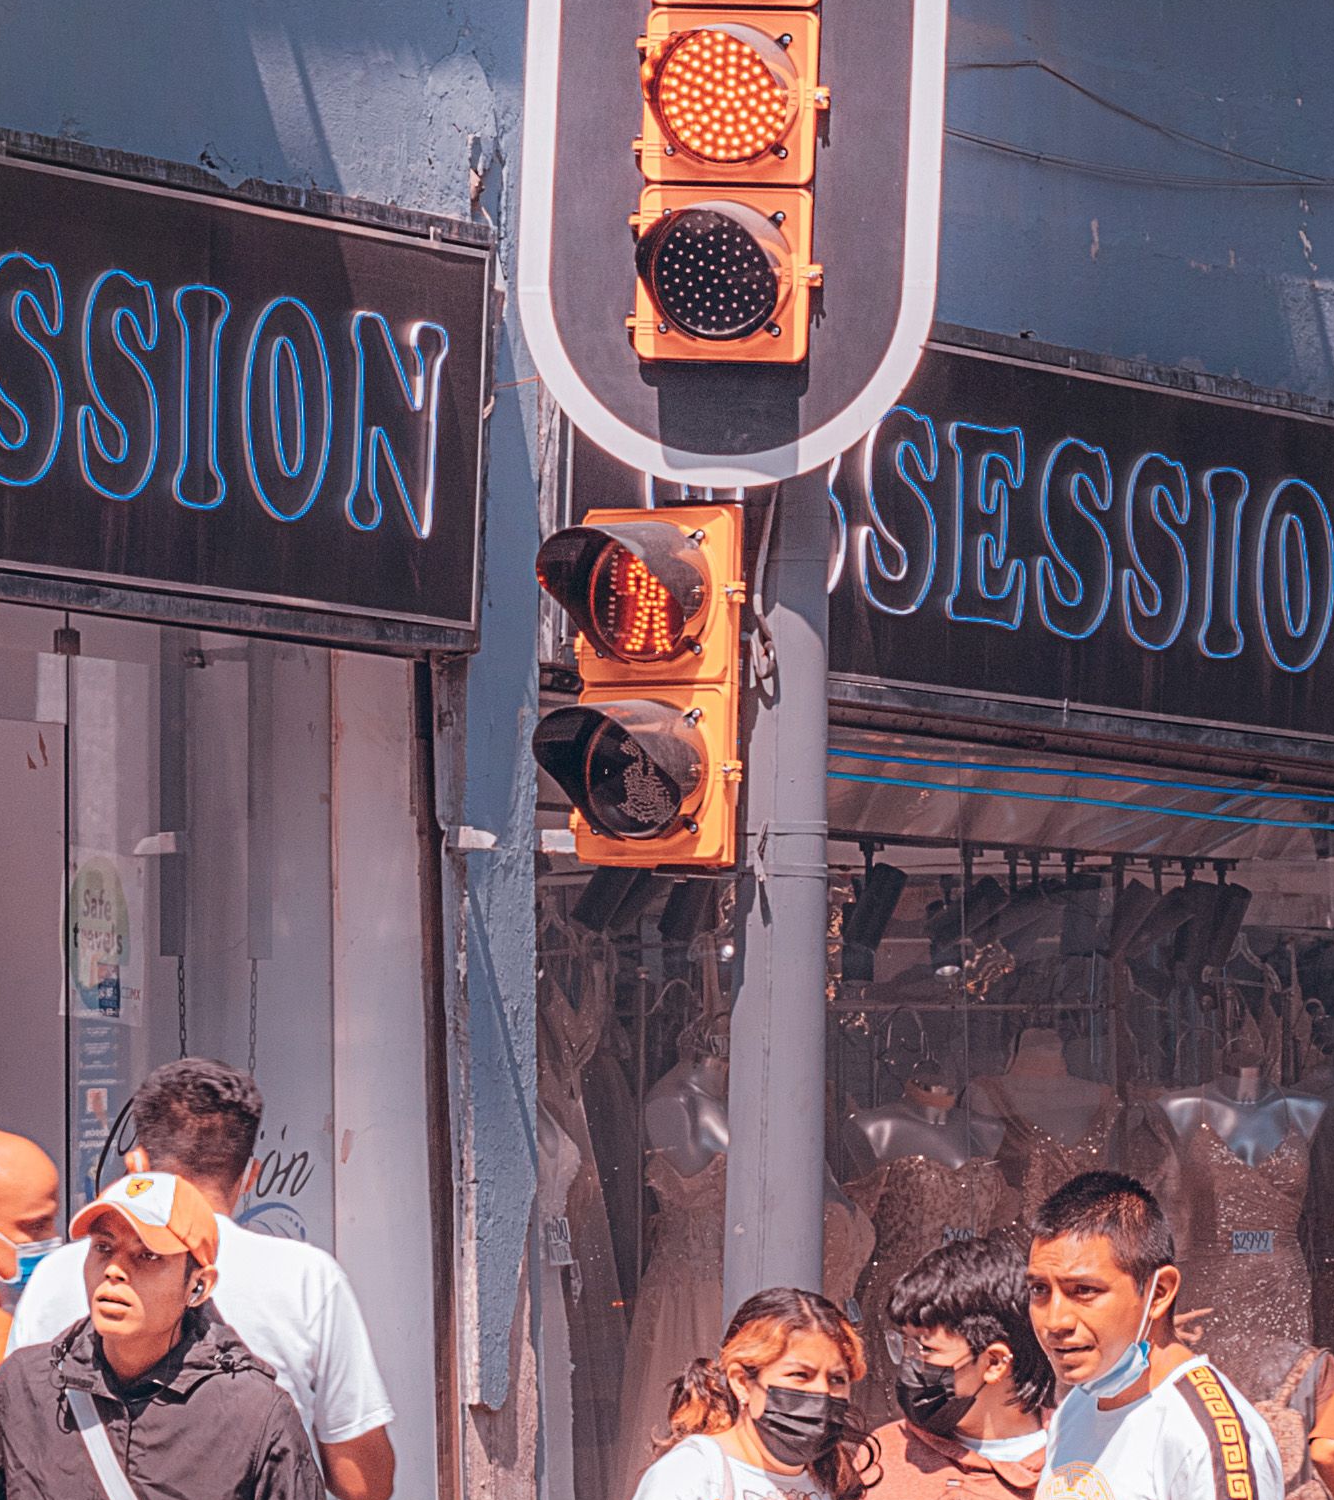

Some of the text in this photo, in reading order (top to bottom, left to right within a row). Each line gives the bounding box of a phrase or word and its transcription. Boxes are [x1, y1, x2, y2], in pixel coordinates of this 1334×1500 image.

[83, 888, 113, 922] Safe
[73, 921, 124, 955] travels
[1234, 1231, 1271, 1252] $2999
